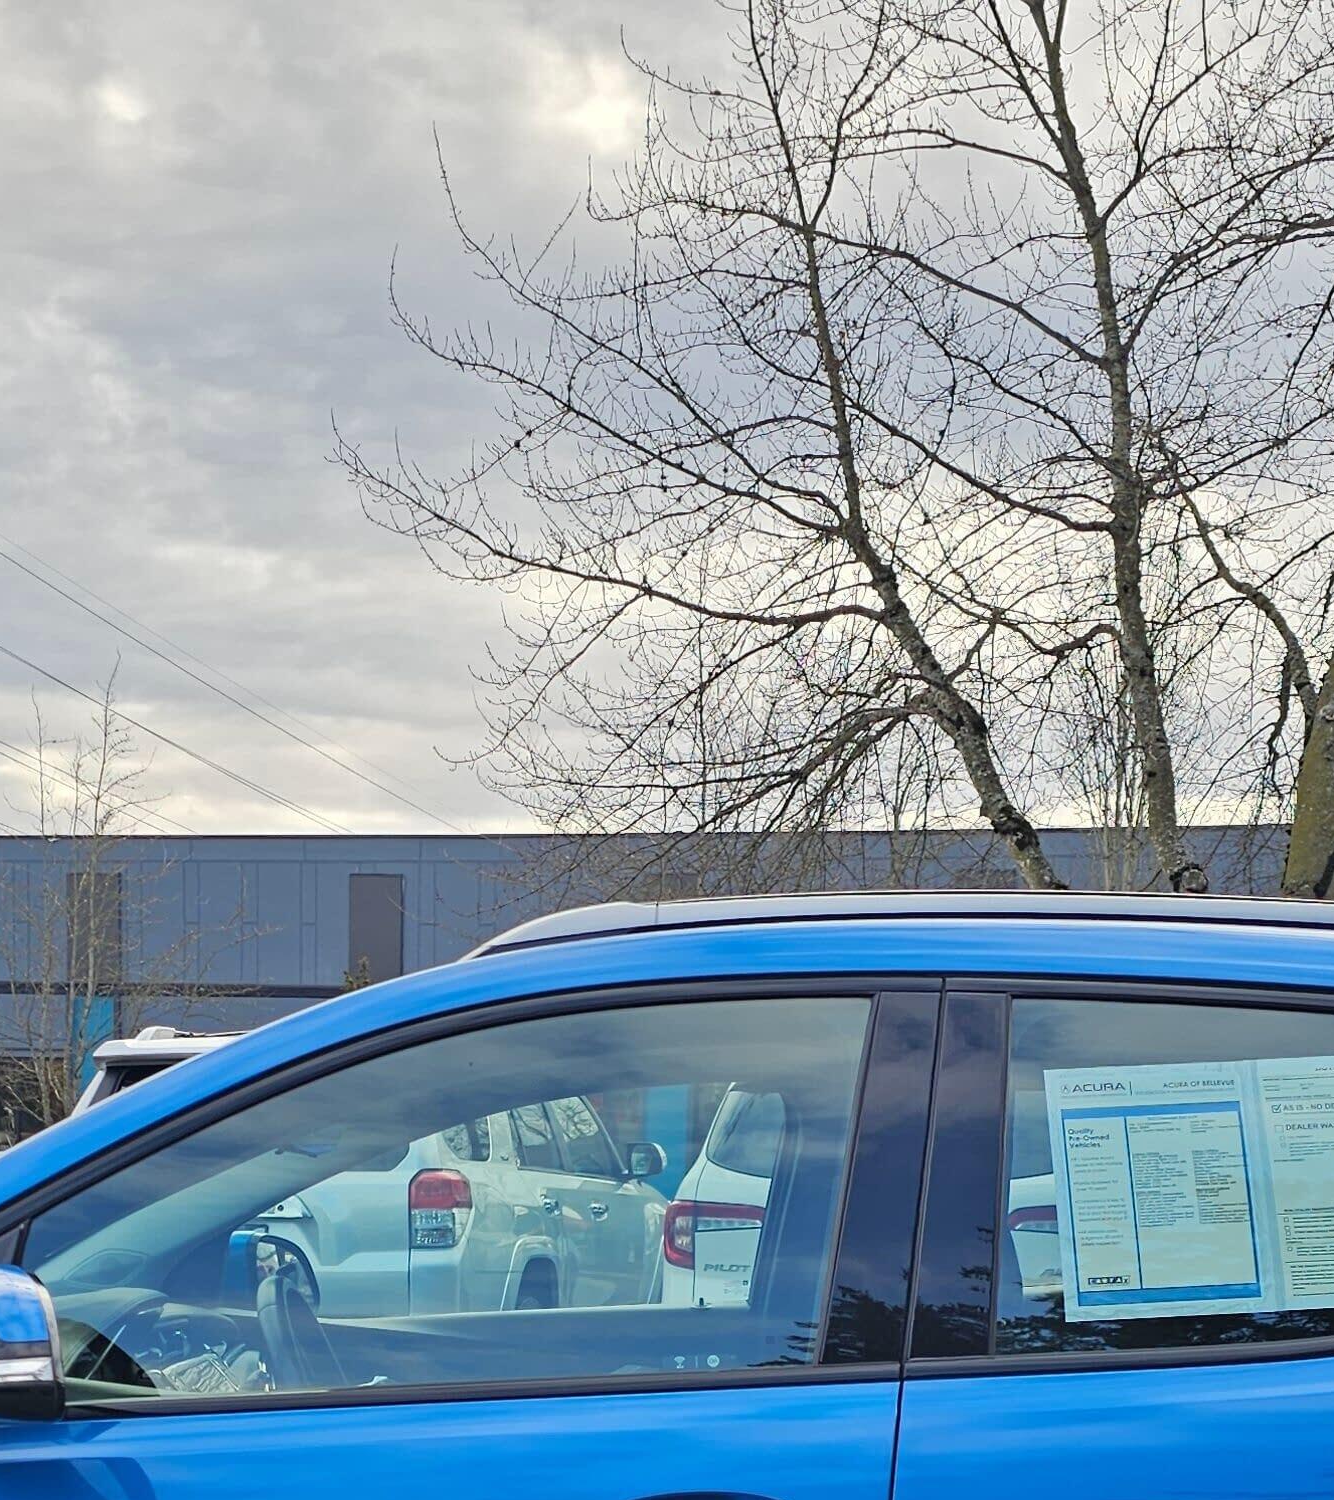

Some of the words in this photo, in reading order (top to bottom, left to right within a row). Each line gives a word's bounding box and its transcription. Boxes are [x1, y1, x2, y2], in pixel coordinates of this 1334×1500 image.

[1072, 1082, 1126, 1093] ACURA
[1202, 1079, 1235, 1087] BELLEVUE
[1067, 1127, 1094, 1136] Quality
[1285, 1123, 1319, 1132] DEALER
[1068, 1133, 1110, 1142] Pre-Owned
[1069, 1141, 1101, 1149] Vehicles
[703, 1263, 751, 1273] PILOT
